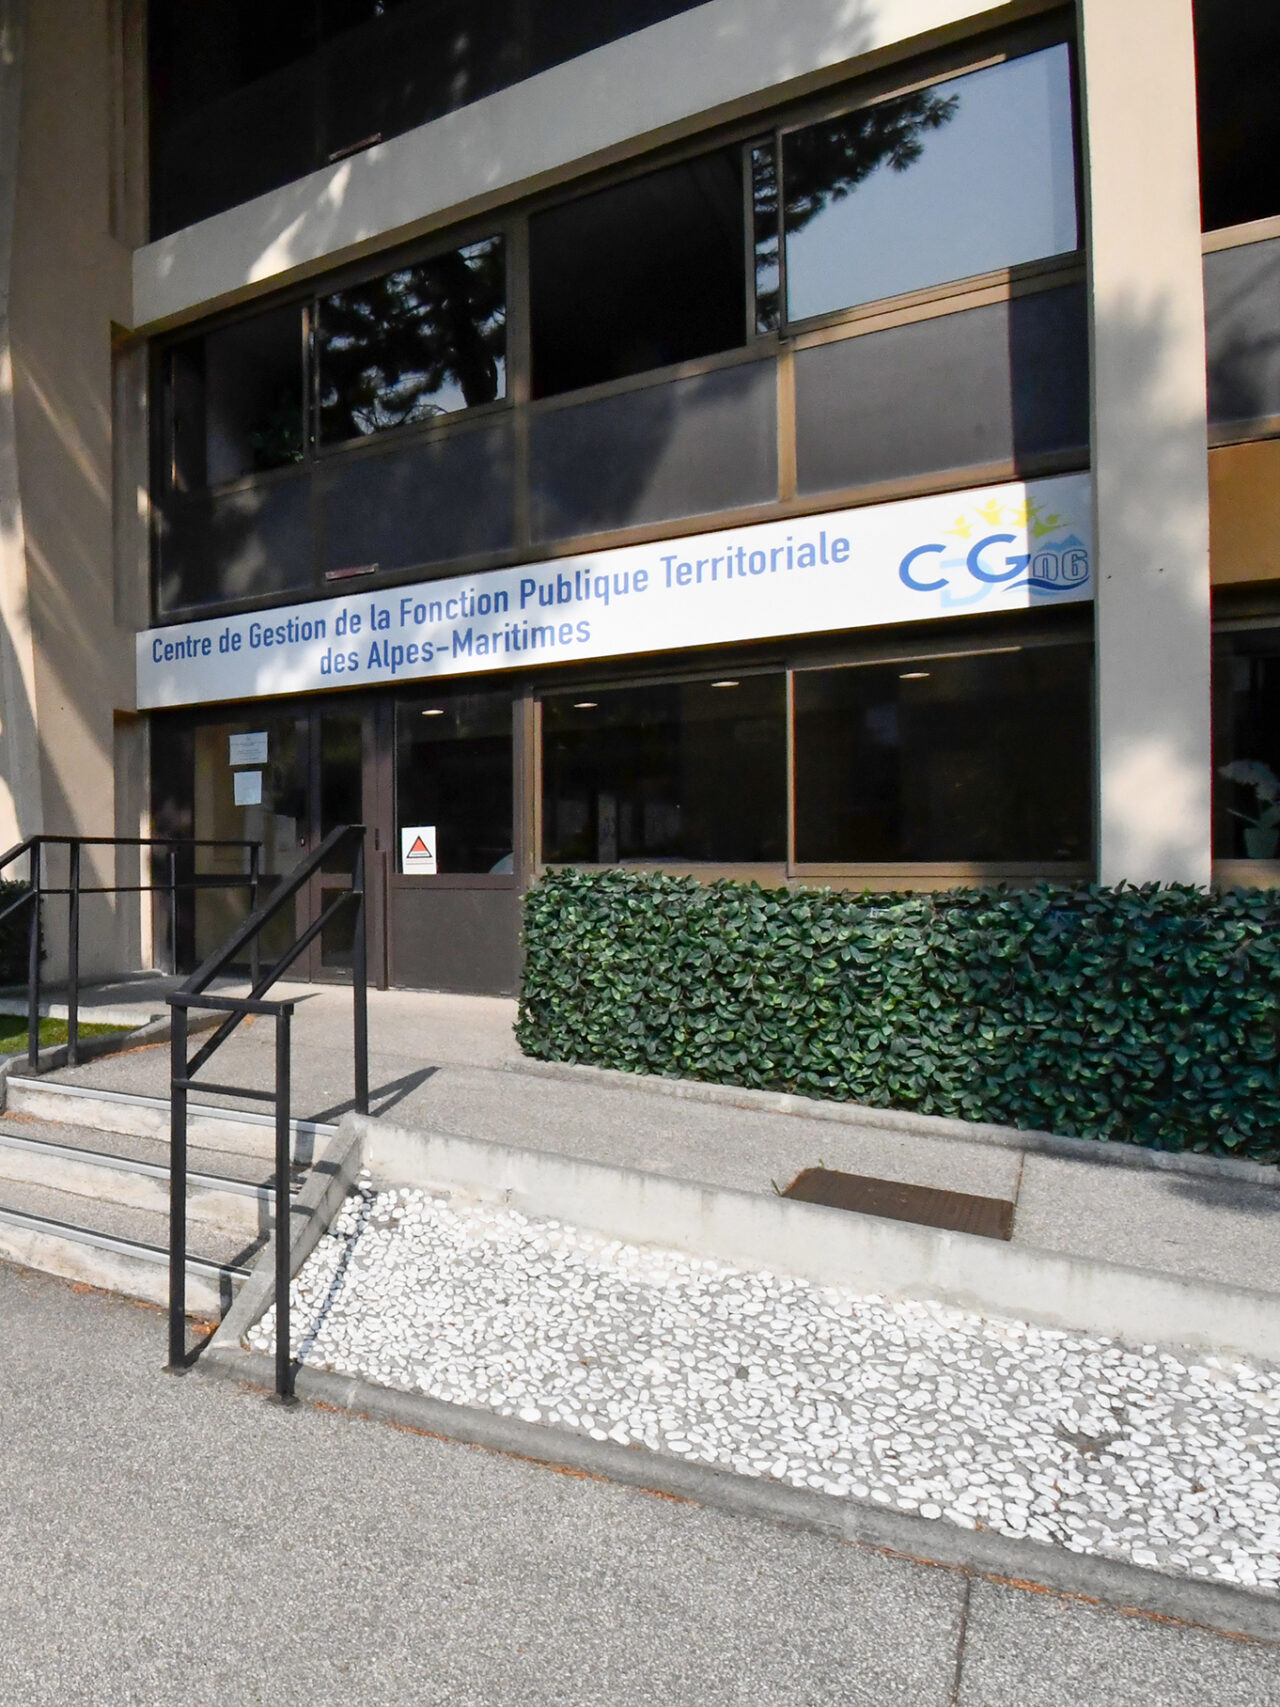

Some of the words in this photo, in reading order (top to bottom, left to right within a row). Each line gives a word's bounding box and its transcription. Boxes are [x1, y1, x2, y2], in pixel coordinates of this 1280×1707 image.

[151, 630, 213, 664] Centre
[219, 627, 242, 655] de
[248, 616, 327, 649] Gestion
[334, 609, 362, 638] de
[370, 603, 391, 632] la
[399, 589, 510, 628] Fonction
[519, 566, 650, 612] Publique
[660, 530, 852, 589] Territoriale
[320, 646, 360, 676] des
[366, 615, 592, 676] Alpes-Maritimes
